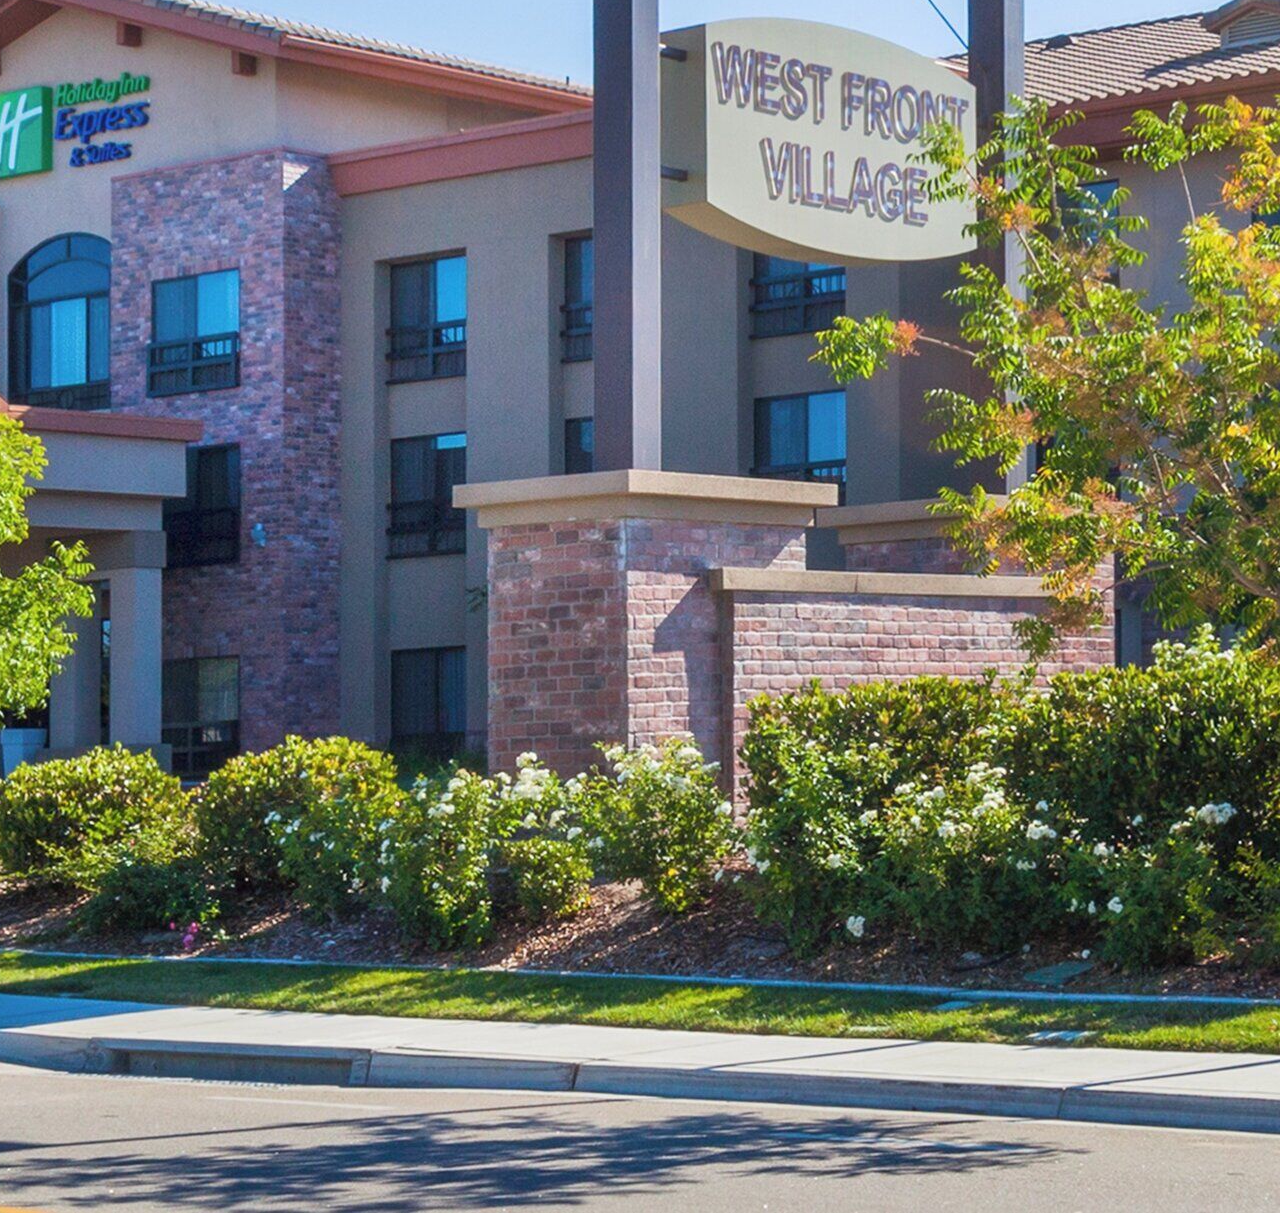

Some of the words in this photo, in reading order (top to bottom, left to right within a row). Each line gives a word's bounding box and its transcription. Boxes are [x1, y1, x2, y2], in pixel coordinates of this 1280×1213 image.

[54, 77, 120, 107] Holiday
[120, 72, 150, 96] Inn
[710, 41, 832, 125] WEST
[841, 72, 970, 147] FRONT
[54, 102, 150, 144] Express
[69, 147, 85, 167] &
[85, 141, 132, 164] Suites
[759, 137, 929, 228] VILLAGE
